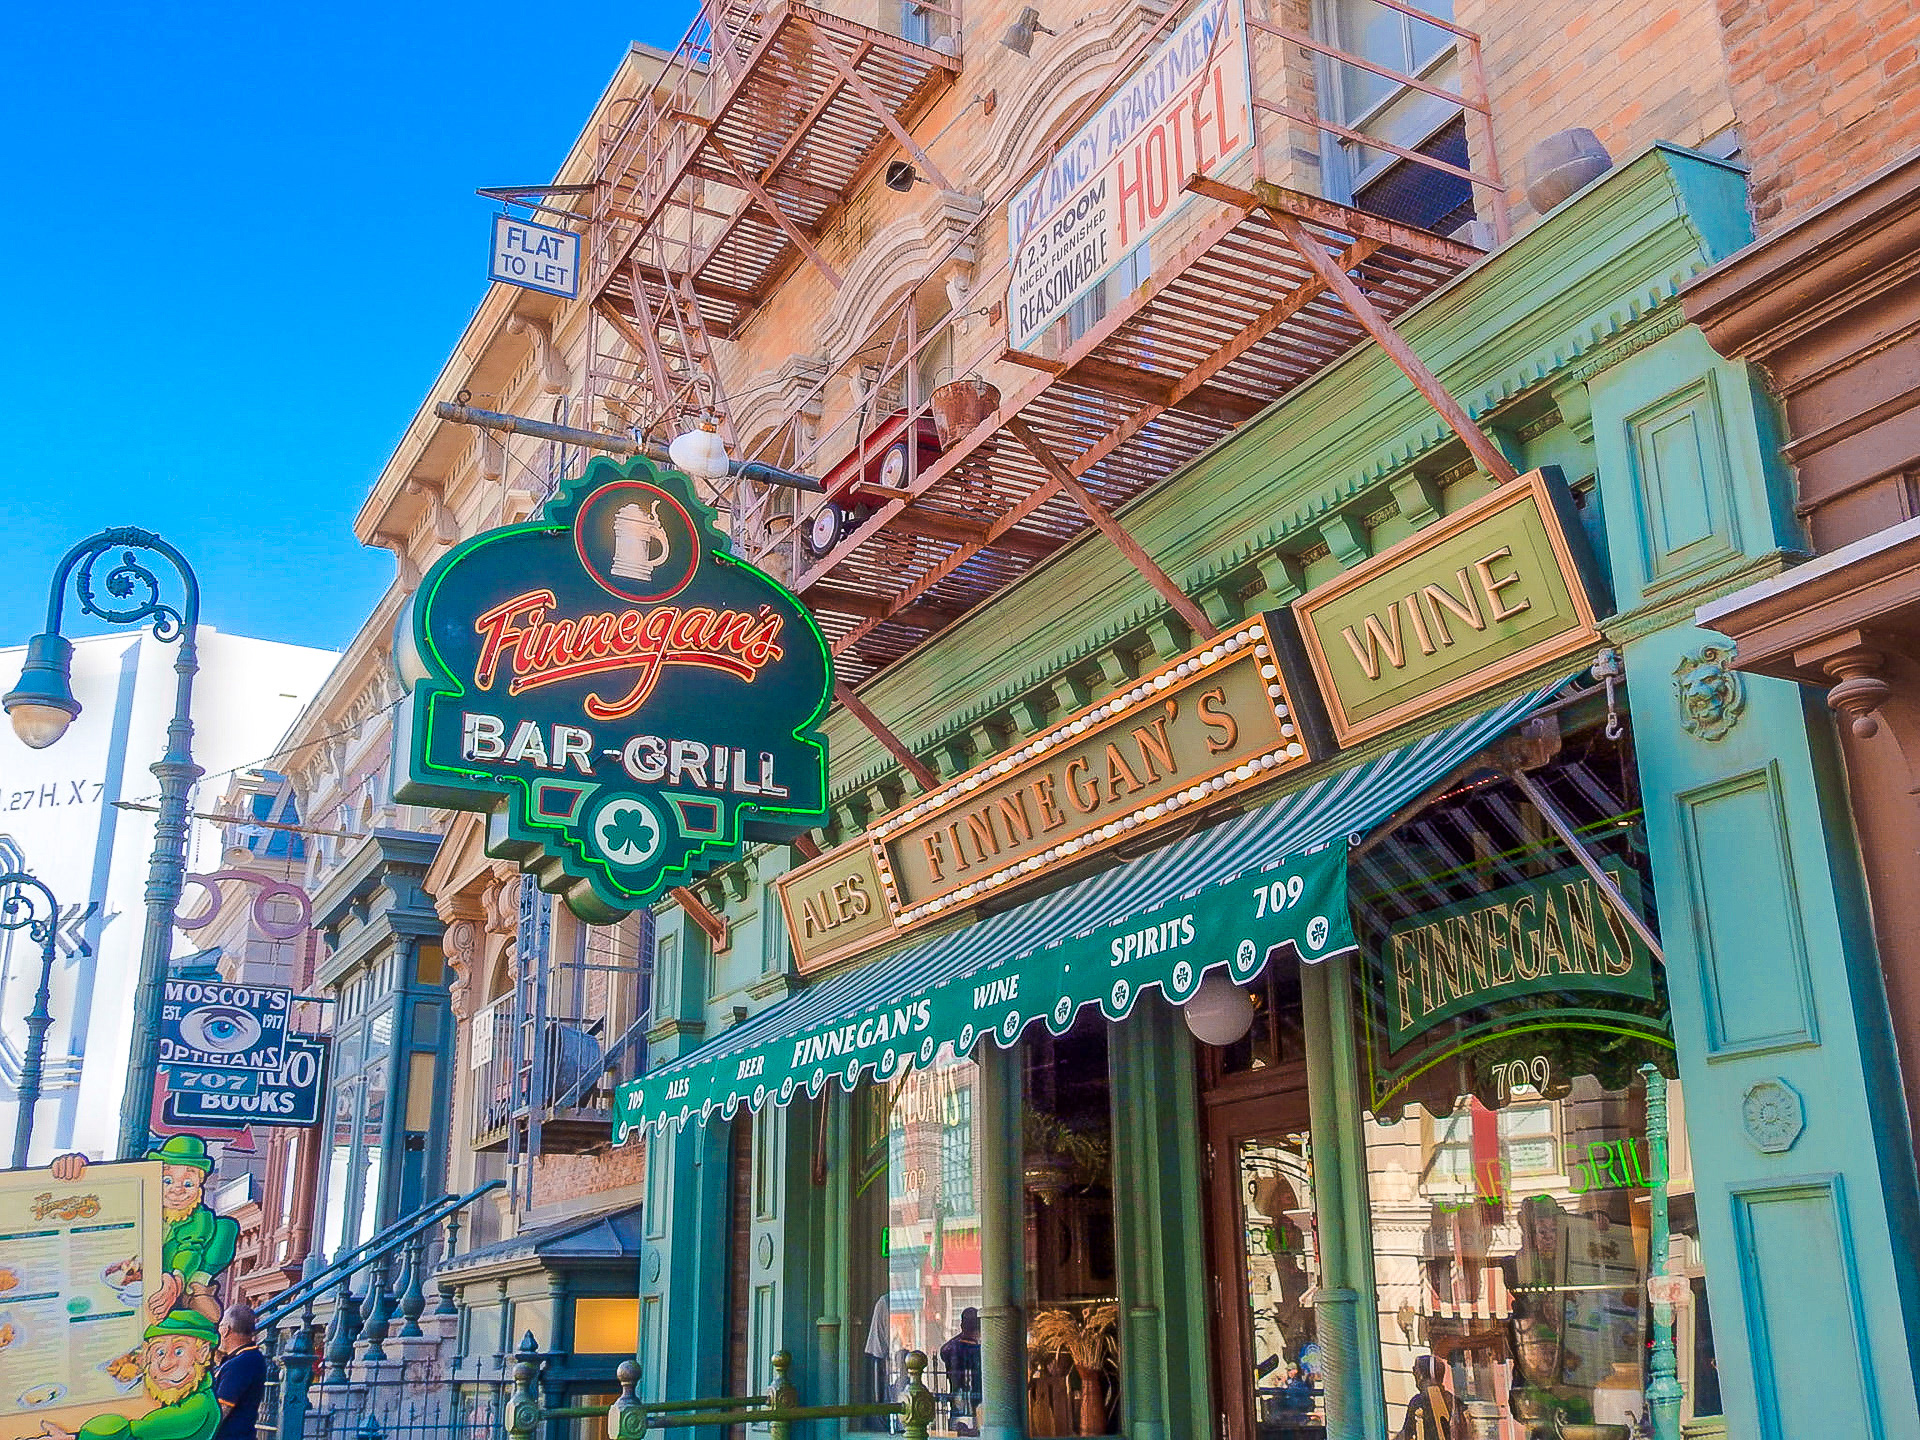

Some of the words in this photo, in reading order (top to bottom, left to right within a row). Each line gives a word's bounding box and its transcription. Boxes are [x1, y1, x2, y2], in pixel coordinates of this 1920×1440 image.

[1016, 123, 1100, 244] DELANCY
[1118, 65, 1240, 248] HOTEL
[507, 226, 564, 260] FLAT
[1053, 177, 1106, 244] ROOM
[501, 253, 526, 275] TO
[533, 261, 568, 285] LET
[1019, 262, 1049, 297] NICELY
[1051, 208, 1106, 267] FURNISHED
[1019, 229, 1108, 339] REASONABLE
[1342, 545, 1532, 680] WINE
[475, 589, 785, 721] Finnegan's
[919, 687, 1241, 883] FINNEGAN'S
[800, 873, 870, 939] ALES
[1390, 870, 1635, 1032] FINNEGANS
[164, 983, 287, 1011] MOSCOT'S
[262, 1014, 284, 1030] 1917
[627, 1089, 644, 1111] 709
[665, 1076, 690, 1101] ALES
[736, 1055, 764, 1081] BEER
[790, 999, 932, 1069] FINNEGAN'S
[972, 973, 1020, 1010] WINE
[1110, 914, 1196, 967] SPIRITS
[1252, 875, 1305, 920] 709
[159, 1038, 279, 1068] OPTICIANS
[179, 1071, 249, 1091] 707
[1490, 1055, 1550, 1100] 709
